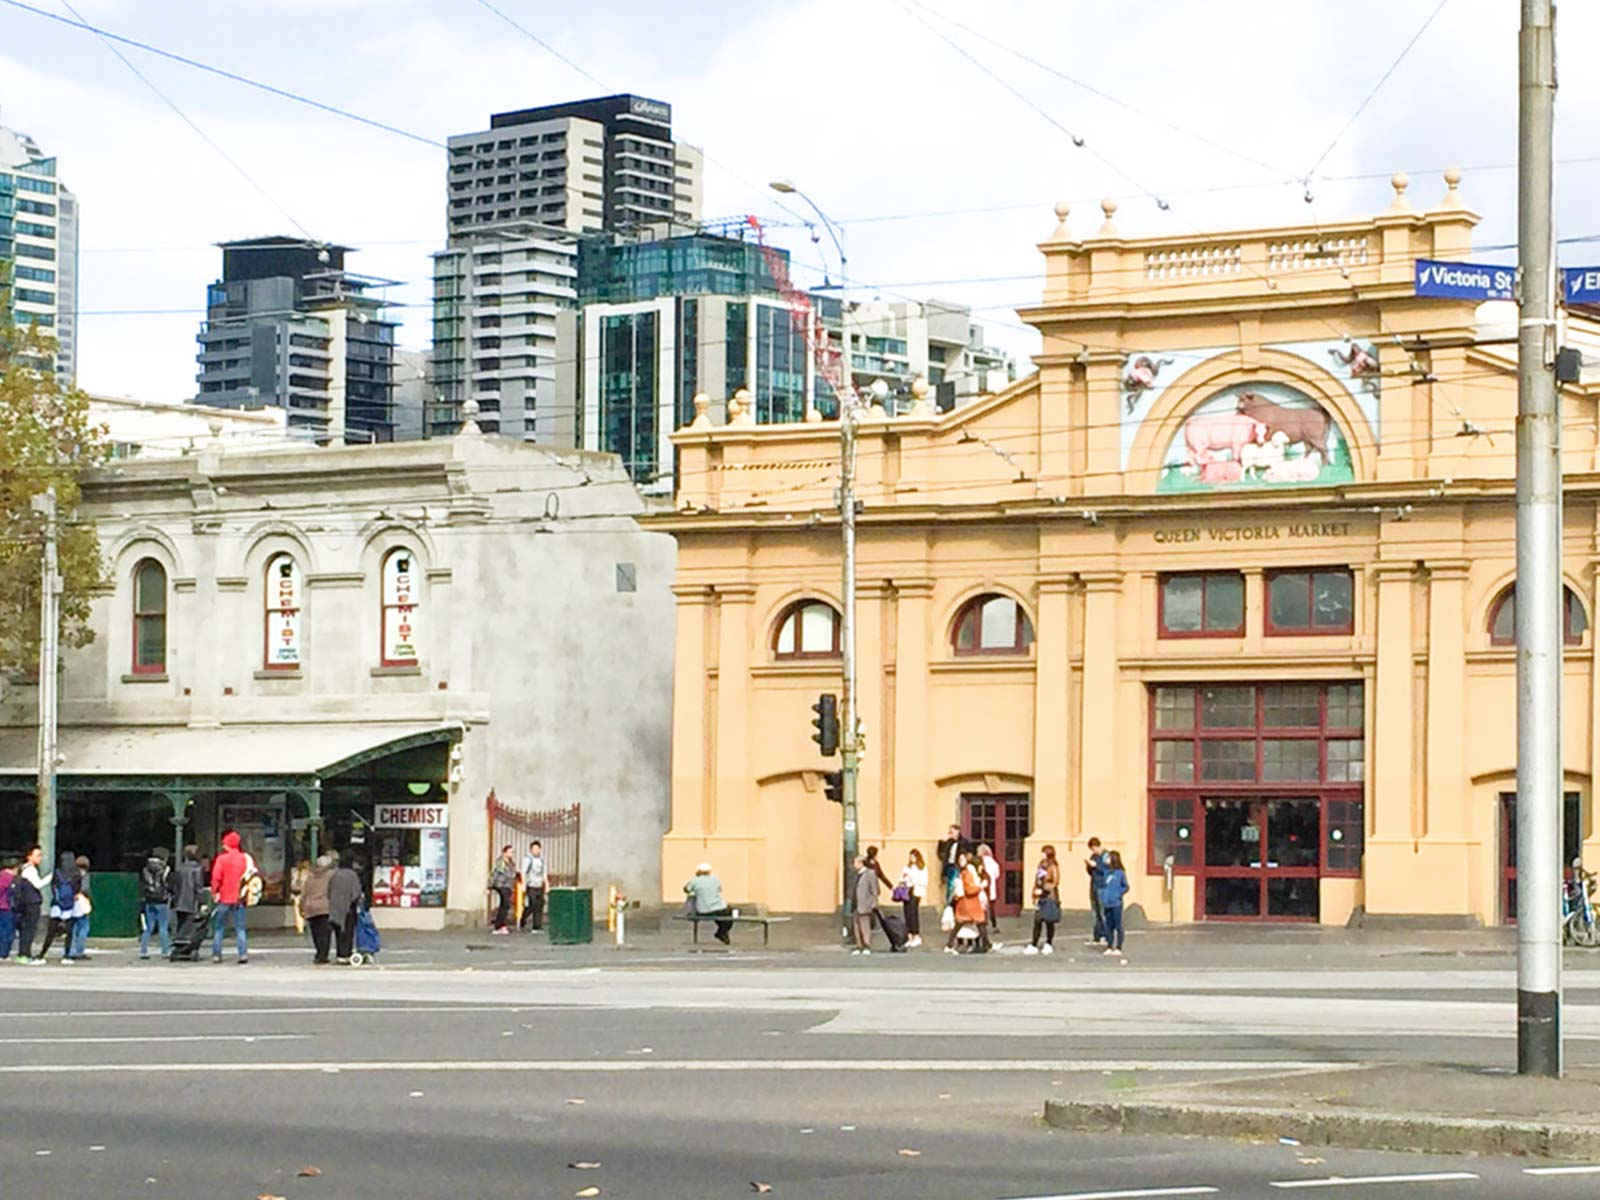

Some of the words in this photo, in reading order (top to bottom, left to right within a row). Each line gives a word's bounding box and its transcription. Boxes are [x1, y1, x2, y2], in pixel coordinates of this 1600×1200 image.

[1432, 267, 1490, 289] Victoria
[1494, 271, 1512, 290] St
[1153, 529, 1200, 543] QUEEN
[1208, 526, 1279, 541] VICTORIA
[1289, 523, 1350, 536] MARKET
[280, 580, 295, 646] CHEMIST
[397, 576, 412, 642] CHEMIST
[380, 807, 443, 824] CHEMIST
